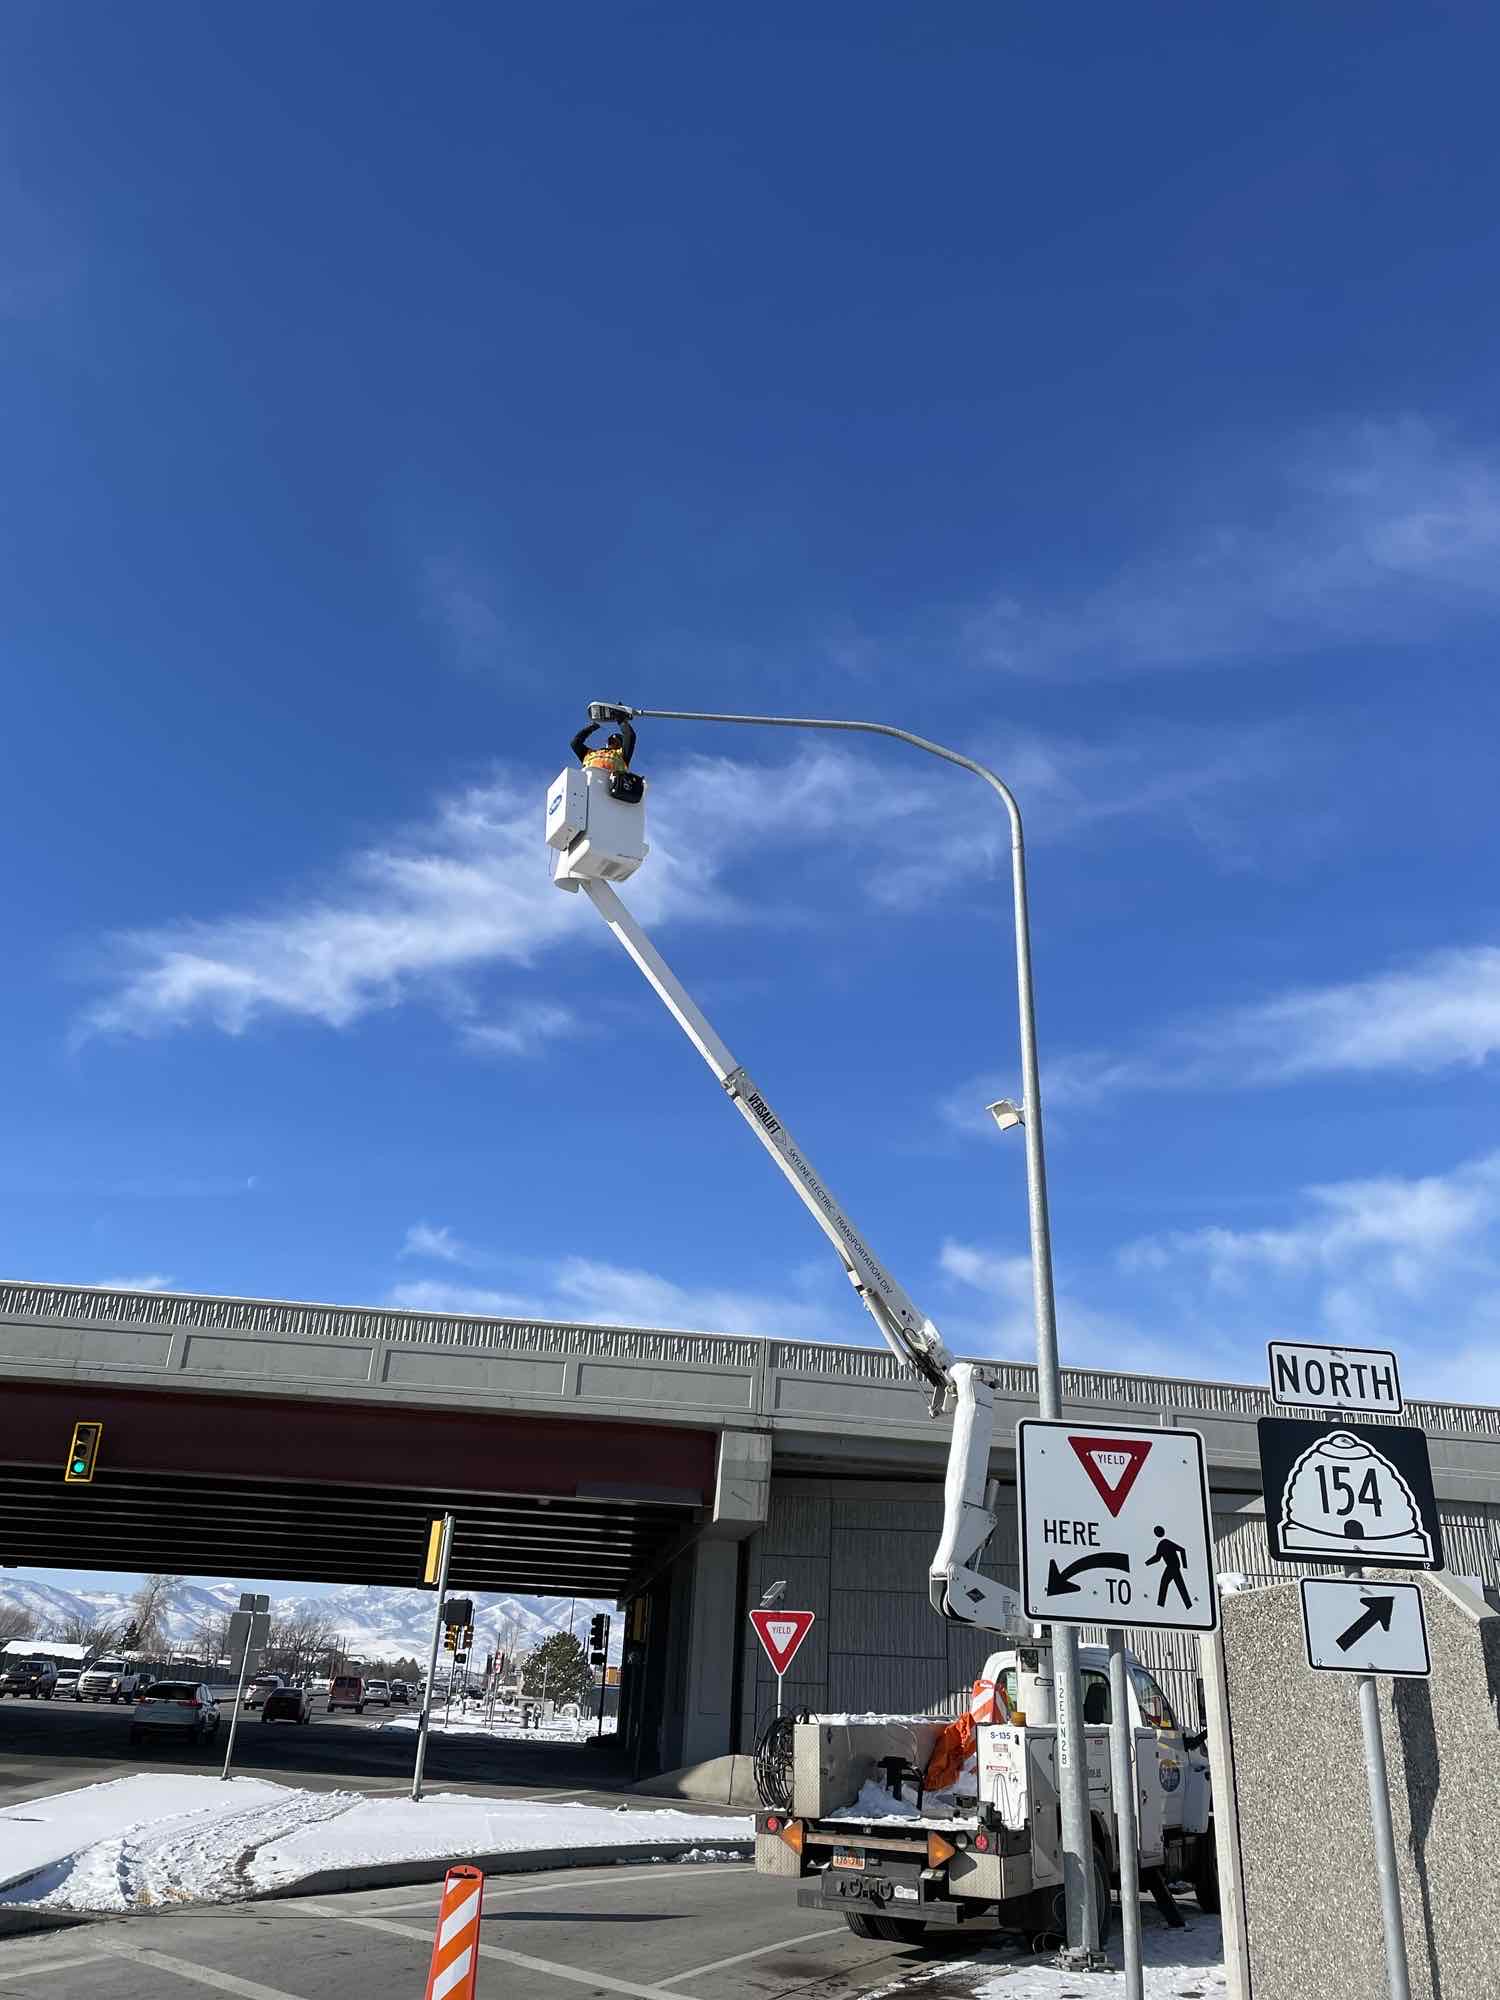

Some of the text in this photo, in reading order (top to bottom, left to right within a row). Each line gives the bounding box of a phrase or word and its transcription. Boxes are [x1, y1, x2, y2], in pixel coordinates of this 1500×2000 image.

[748, 1093, 781, 1134] VERSALIFT
[808, 1178, 835, 1213] ELECTRIC
[836, 1215, 881, 1280] TRANSPORTATION
[880, 1279, 894, 1295] DIV
[1276, 1354, 1394, 1400] NORTH
[1097, 1454, 1125, 1465] YIELD
[1314, 1465, 1382, 1517] 154
[1043, 1519, 1101, 1547] HERE
[1105, 1579, 1131, 1604] TO
[772, 1626, 792, 1634] YIELD
[990, 1731, 1011, 1740] S-135
